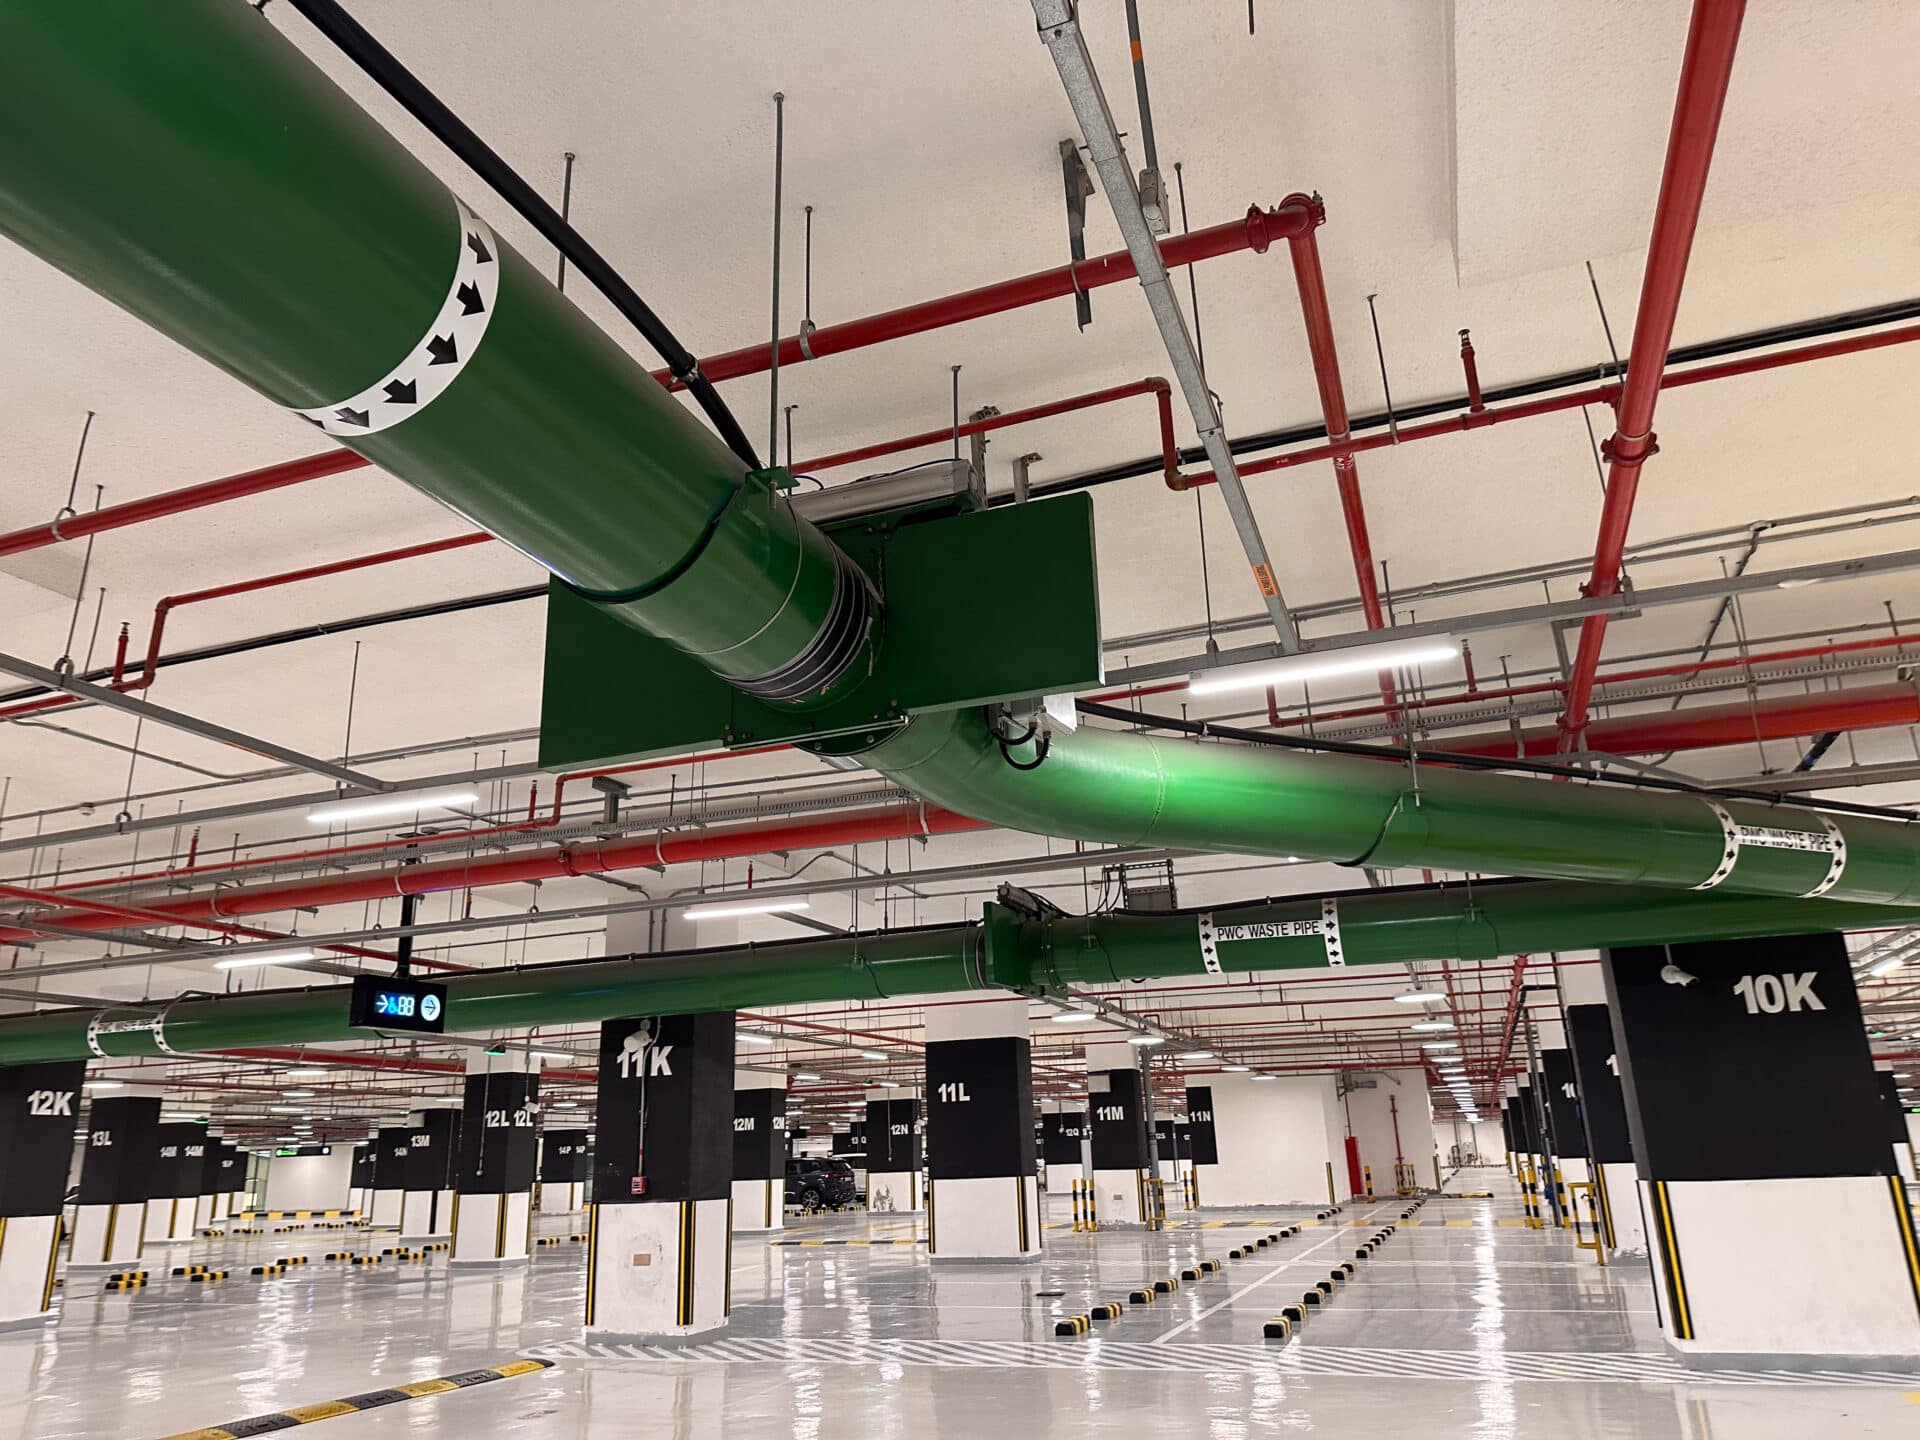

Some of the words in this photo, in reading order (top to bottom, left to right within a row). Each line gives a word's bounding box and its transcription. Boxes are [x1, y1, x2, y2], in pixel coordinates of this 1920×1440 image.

[1768, 829, 1807, 849] WASTE
[1808, 833, 1832, 851] PIPE
[1217, 926, 1244, 940] PWC
[1248, 923, 1289, 938] WASTE
[1293, 921, 1320, 935] PIPE
[1733, 971, 1827, 1014] 10K
[616, 1045, 674, 1078] 11K
[938, 1082, 971, 1103] 11L
[27, 1090, 75, 1116] 12K
[485, 1110, 510, 1128] 12L
[513, 1109, 534, 1127] 12L
[1096, 1106, 1124, 1121] 11M
[1190, 1111, 1211, 1122] 11N
[733, 1117, 755, 1131] 12M
[890, 1124, 909, 1136] 12N
[91, 1131, 113, 1147] 13L
[411, 1134, 430, 1148] 13M
